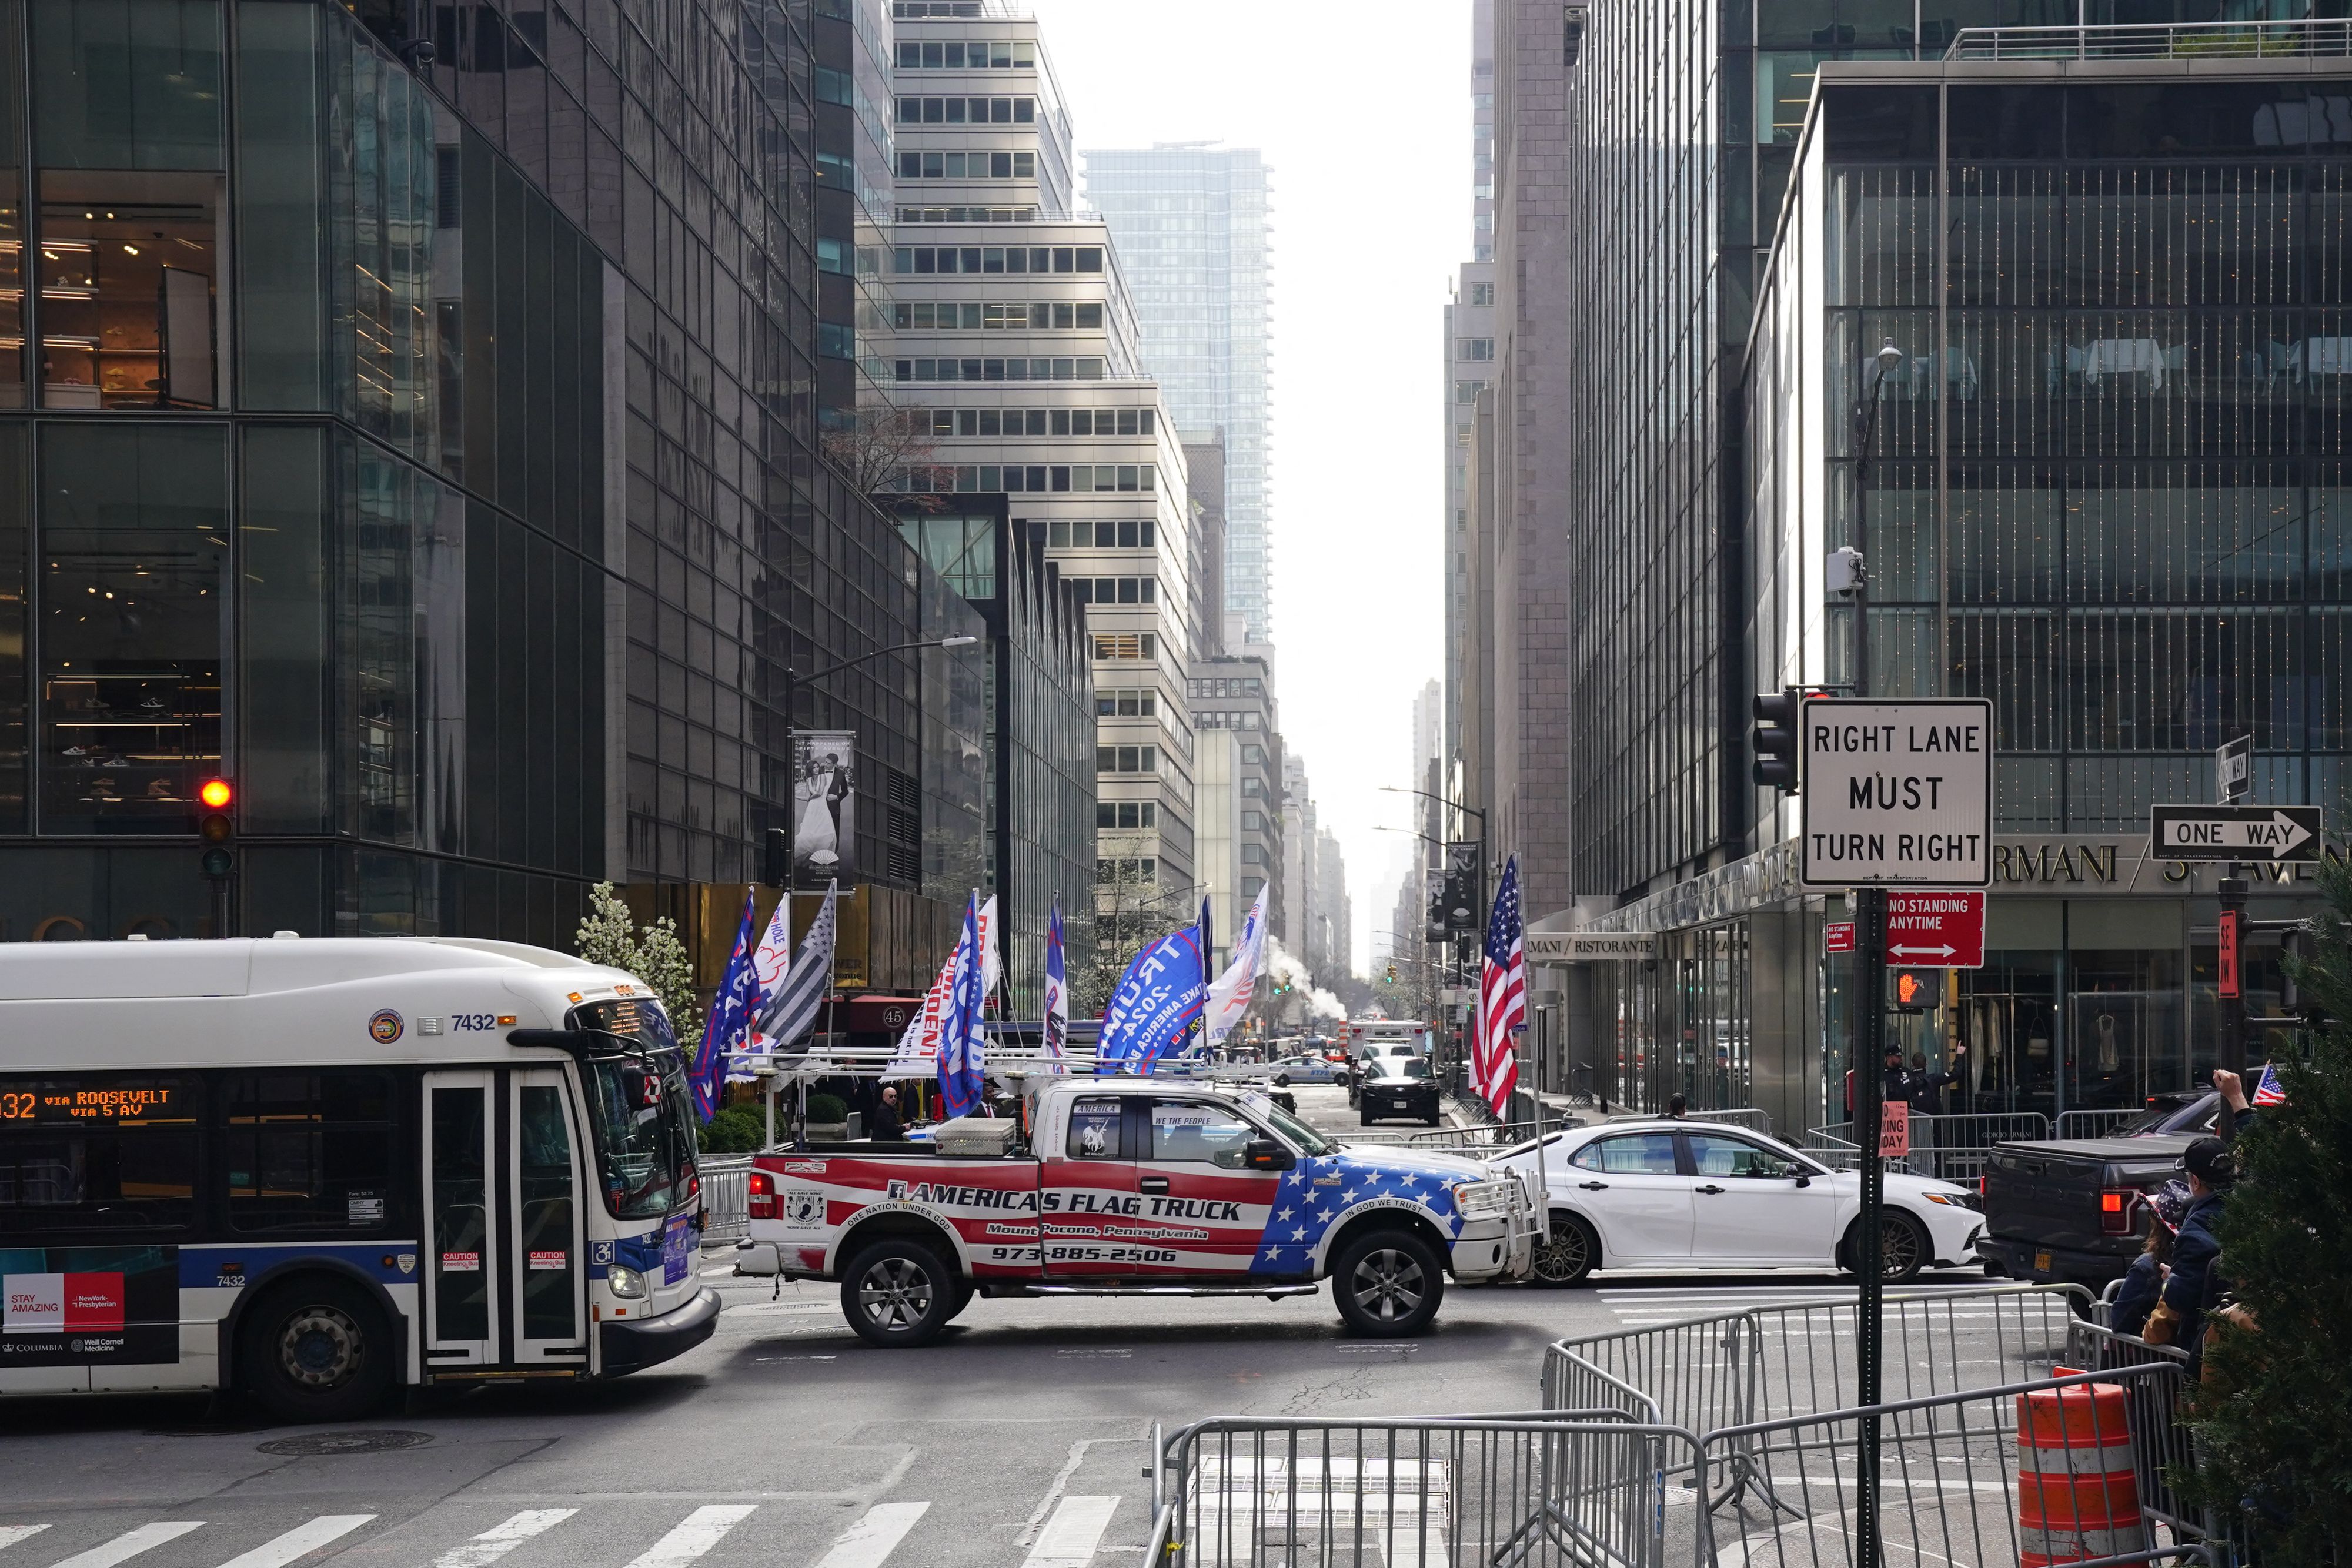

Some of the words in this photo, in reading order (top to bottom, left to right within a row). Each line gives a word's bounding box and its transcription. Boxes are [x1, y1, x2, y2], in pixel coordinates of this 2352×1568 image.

[1815, 726, 1896, 753] RIGHT
[1909, 726, 1980, 753] LANE
[2231, 755, 2244, 780] WAY
[1849, 777, 1943, 810] MUST
[2177, 823, 2224, 844] ONE
[2246, 824, 2295, 845] WAY
[1812, 834, 1884, 861] TURN
[1898, 834, 1980, 861] RIGHT
[1993, 844, 2119, 882] RMANI
[1889, 899, 1906, 912] NO
[1909, 899, 1969, 913] STANDING
[1889, 916, 1943, 930] ANYTIME
[1528, 941, 1561, 952] MANI
[1575, 940, 1654, 953] RISTORANTE
[451, 1014, 495, 1031] 7432
[886, 1011, 902, 1023] 45
[0, 1093, 35, 1118] 32
[76, 1090, 169, 1105] ROOSEVELT
[102, 1105, 113, 1116] 5
[119, 1104, 142, 1116] AV
[1155, 1117, 1167, 1125] WE
[1184, 1117, 1211, 1125] PEOPLE
[1882, 1135, 1904, 1148] DAY
[910, 1184, 1062, 1212] AMERICA'S
[1068, 1193, 1142, 1215] FLAG
[1150, 1197, 1241, 1221] TRUCK
[1345, 1210, 1355, 1218] IN
[1356, 1201, 1375, 1212] GOD
[1394, 1199, 1423, 1213] TRUST
[847, 1212, 864, 1227] ONE
[865, 1203, 898, 1215] NATION
[902, 1203, 932, 1217] UNDER
[933, 1215, 950, 1231] GOD
[988, 1223, 1038, 1236] Mount
[1041, 1223, 1101, 1236] Pocono,
[1104, 1225, 1209, 1240] Pennsylvania
[530, 1251, 565, 1259] CAUTION
[991, 1247, 1177, 1262] 973-885-2506
[216, 1275, 245, 1286] 7432
[11, 1294, 35, 1303] STAY
[11, 1303, 58, 1313] AMAZING
[16, 1343, 64, 1352] COLUMBIA
